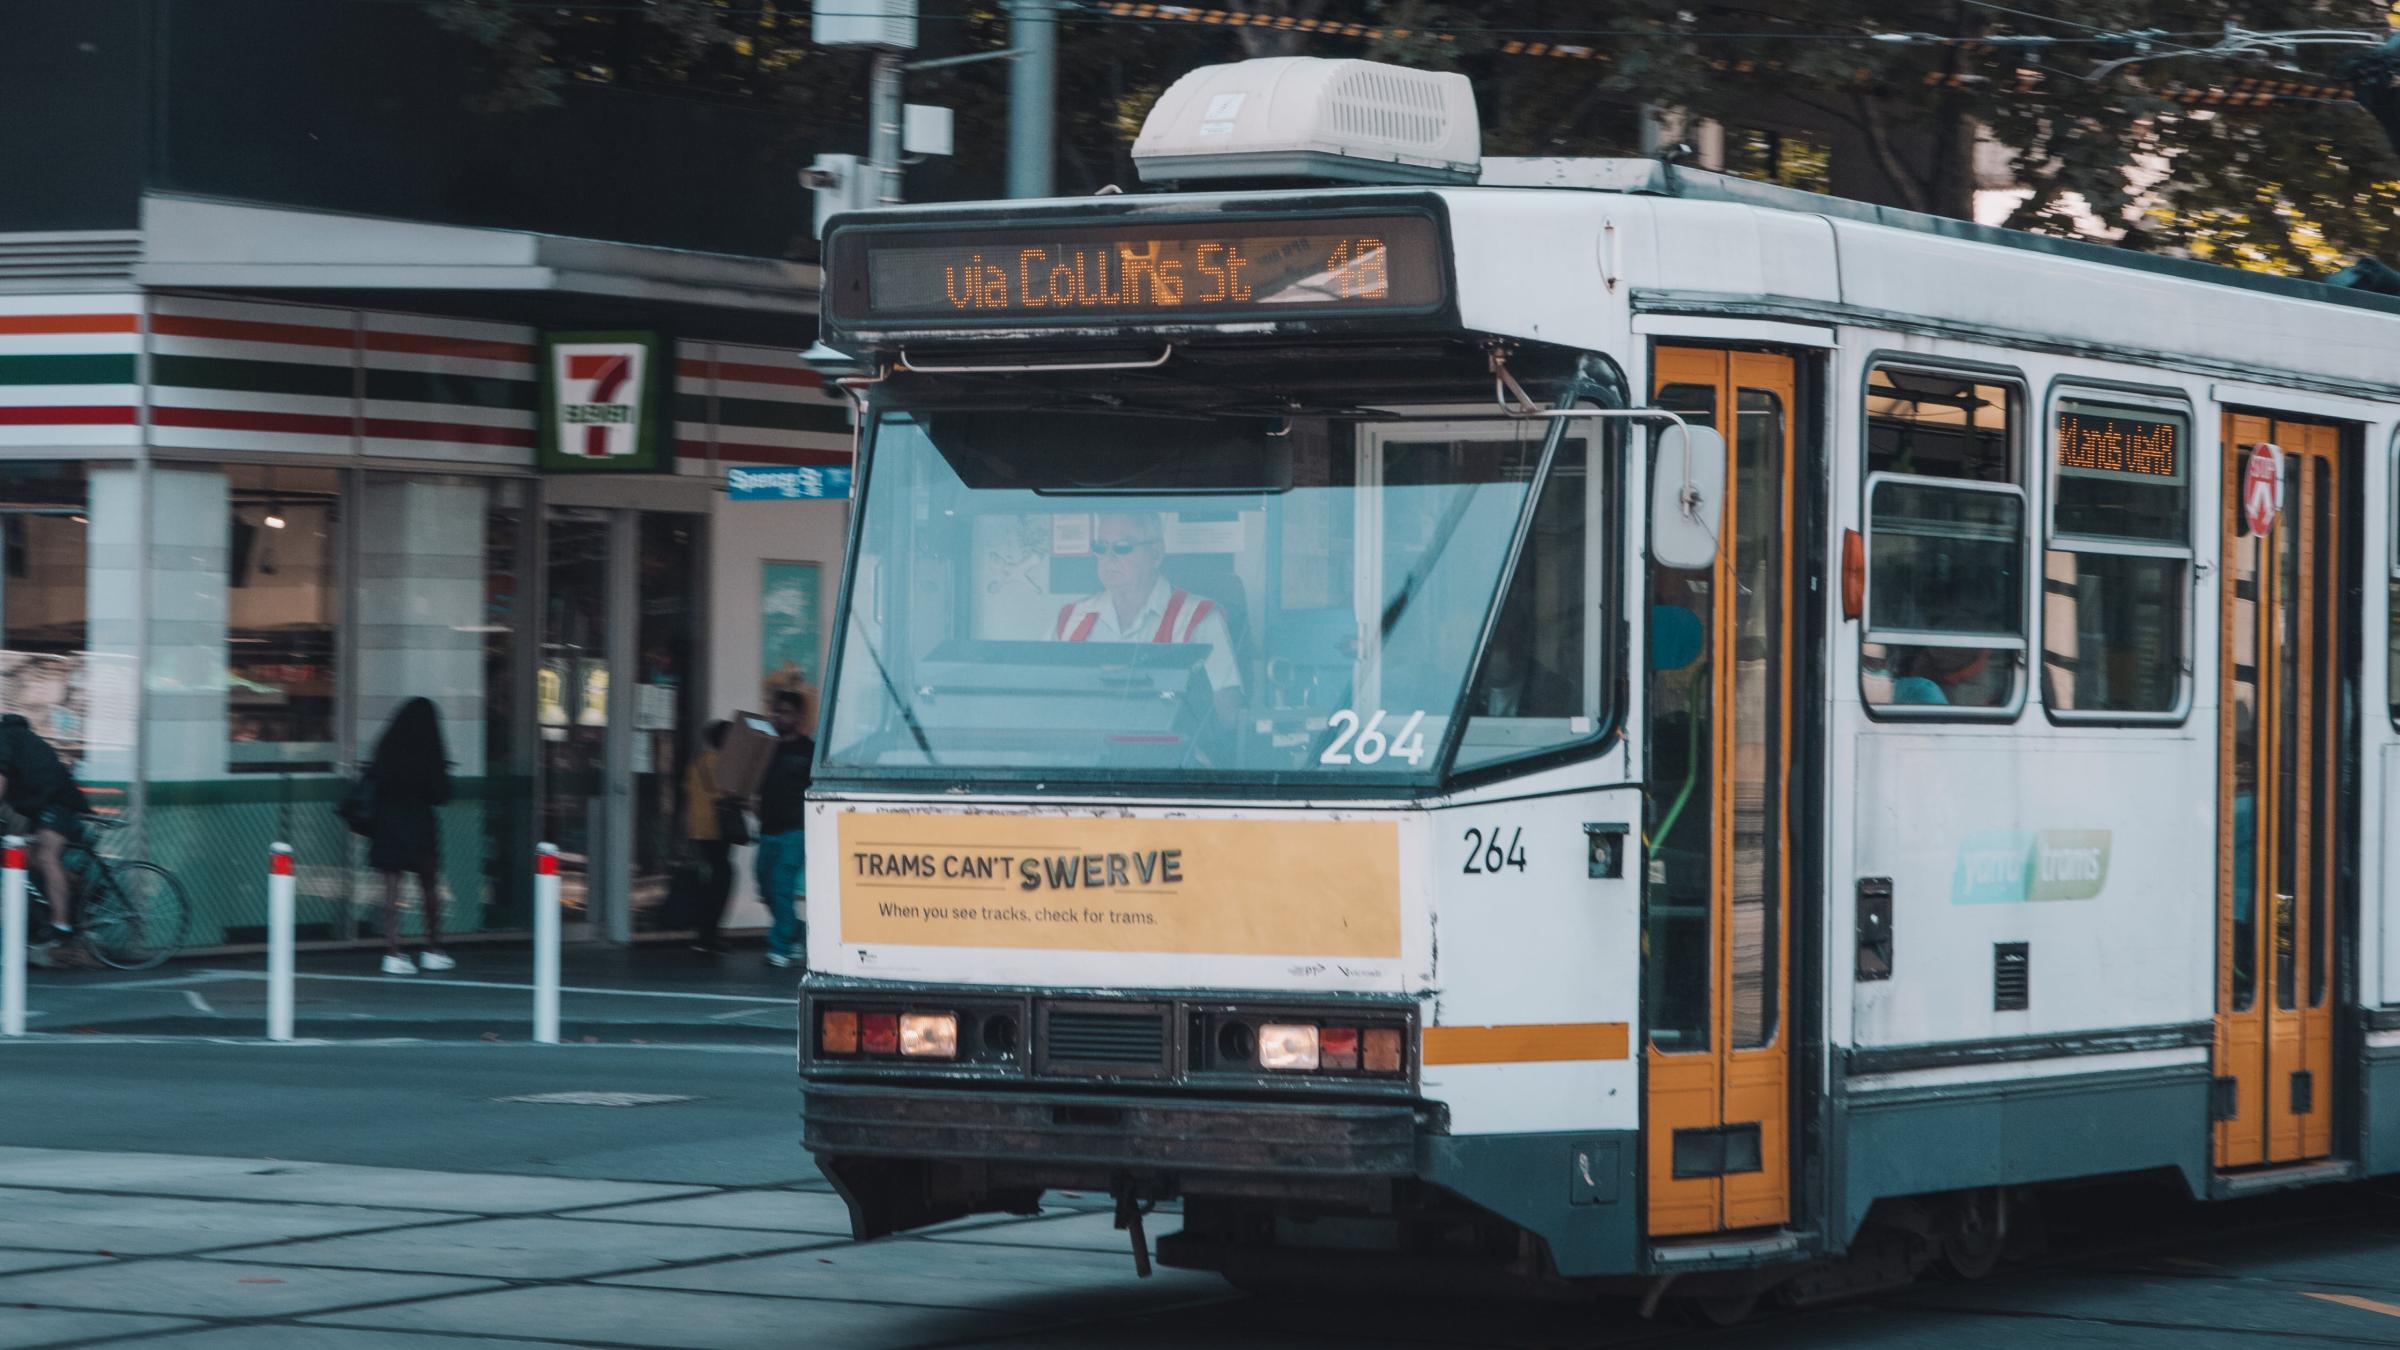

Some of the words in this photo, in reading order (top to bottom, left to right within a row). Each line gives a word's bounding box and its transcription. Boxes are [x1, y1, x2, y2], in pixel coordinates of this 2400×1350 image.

[945, 254, 1008, 308] via
[1021, 248, 1184, 306] Collins
[1197, 243, 1251, 302] St
[1327, 238, 1386, 300] 48
[565, 354, 632, 456] 7
[1320, 709, 1426, 766] 264
[854, 852, 937, 878] TRAMS
[943, 854, 1015, 879] CAN'T
[1020, 848, 1183, 890] SWERVE
[1463, 826, 1527, 874] 264
[878, 902, 919, 918] When
[923, 906, 949, 923] you
[952, 906, 977, 919] see
[1035, 907, 1078, 923] check
[1083, 907, 1105, 924] for
[1109, 909, 1159, 925] trams.
